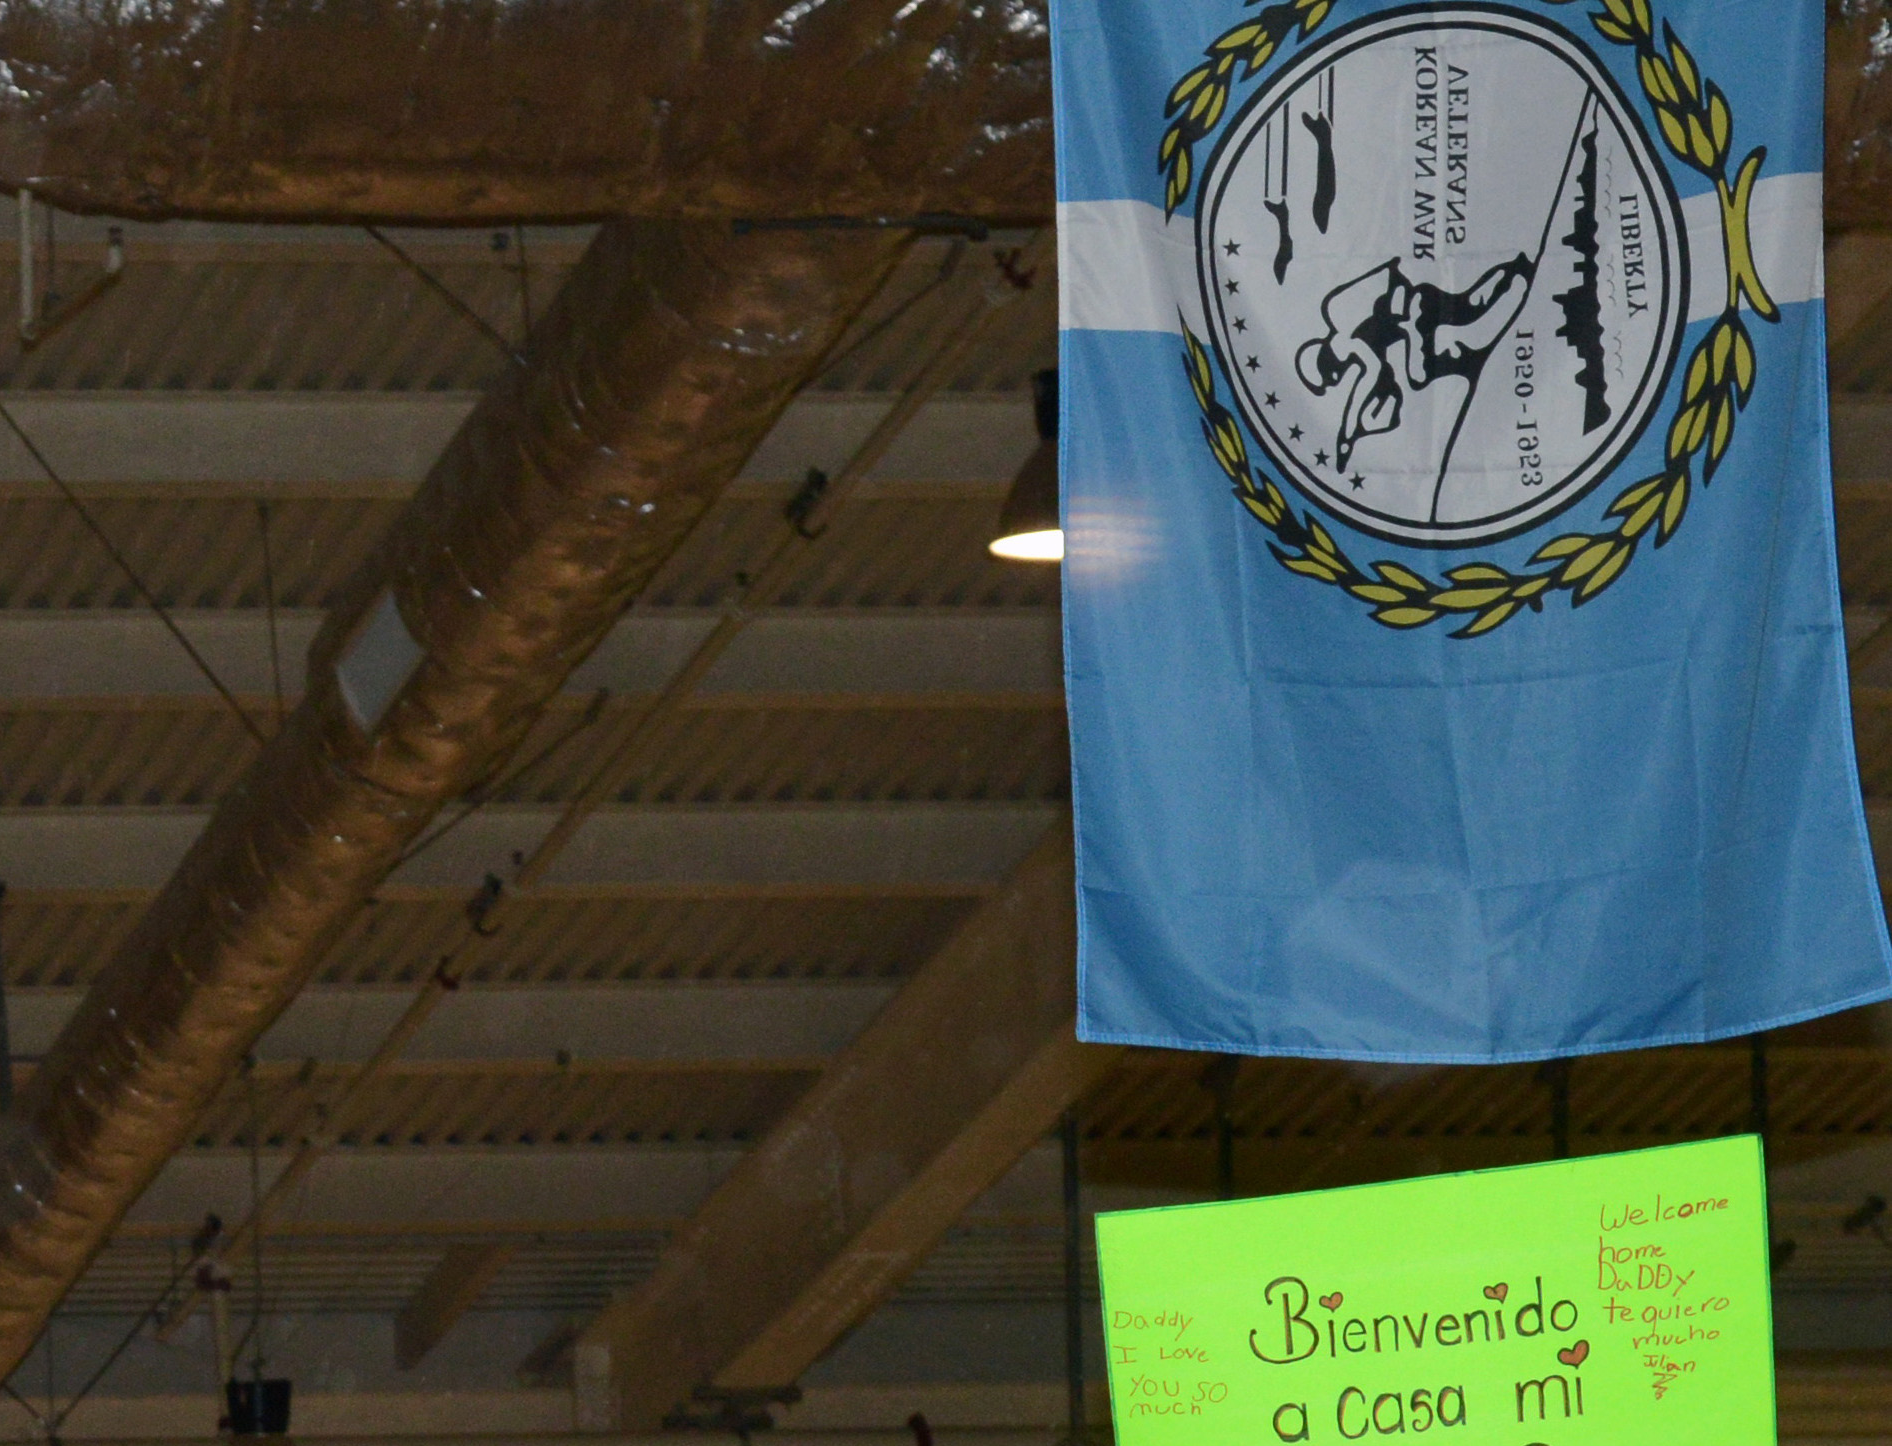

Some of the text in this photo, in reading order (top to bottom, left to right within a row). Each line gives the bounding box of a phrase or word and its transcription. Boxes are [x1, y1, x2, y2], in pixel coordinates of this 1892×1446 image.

[1599, 1193, 1730, 1232] Welcome
[1598, 1235, 1666, 1264] home
[1112, 1310, 1194, 1342] Daddy
[1248, 1274, 1580, 1366] Bienvenido
[1602, 1296, 1730, 1336] te quiero
[1112, 1344, 1138, 1365] I
[1632, 1324, 1721, 1351] mucho
[1272, 1340, 1591, 1443] a casa mi
